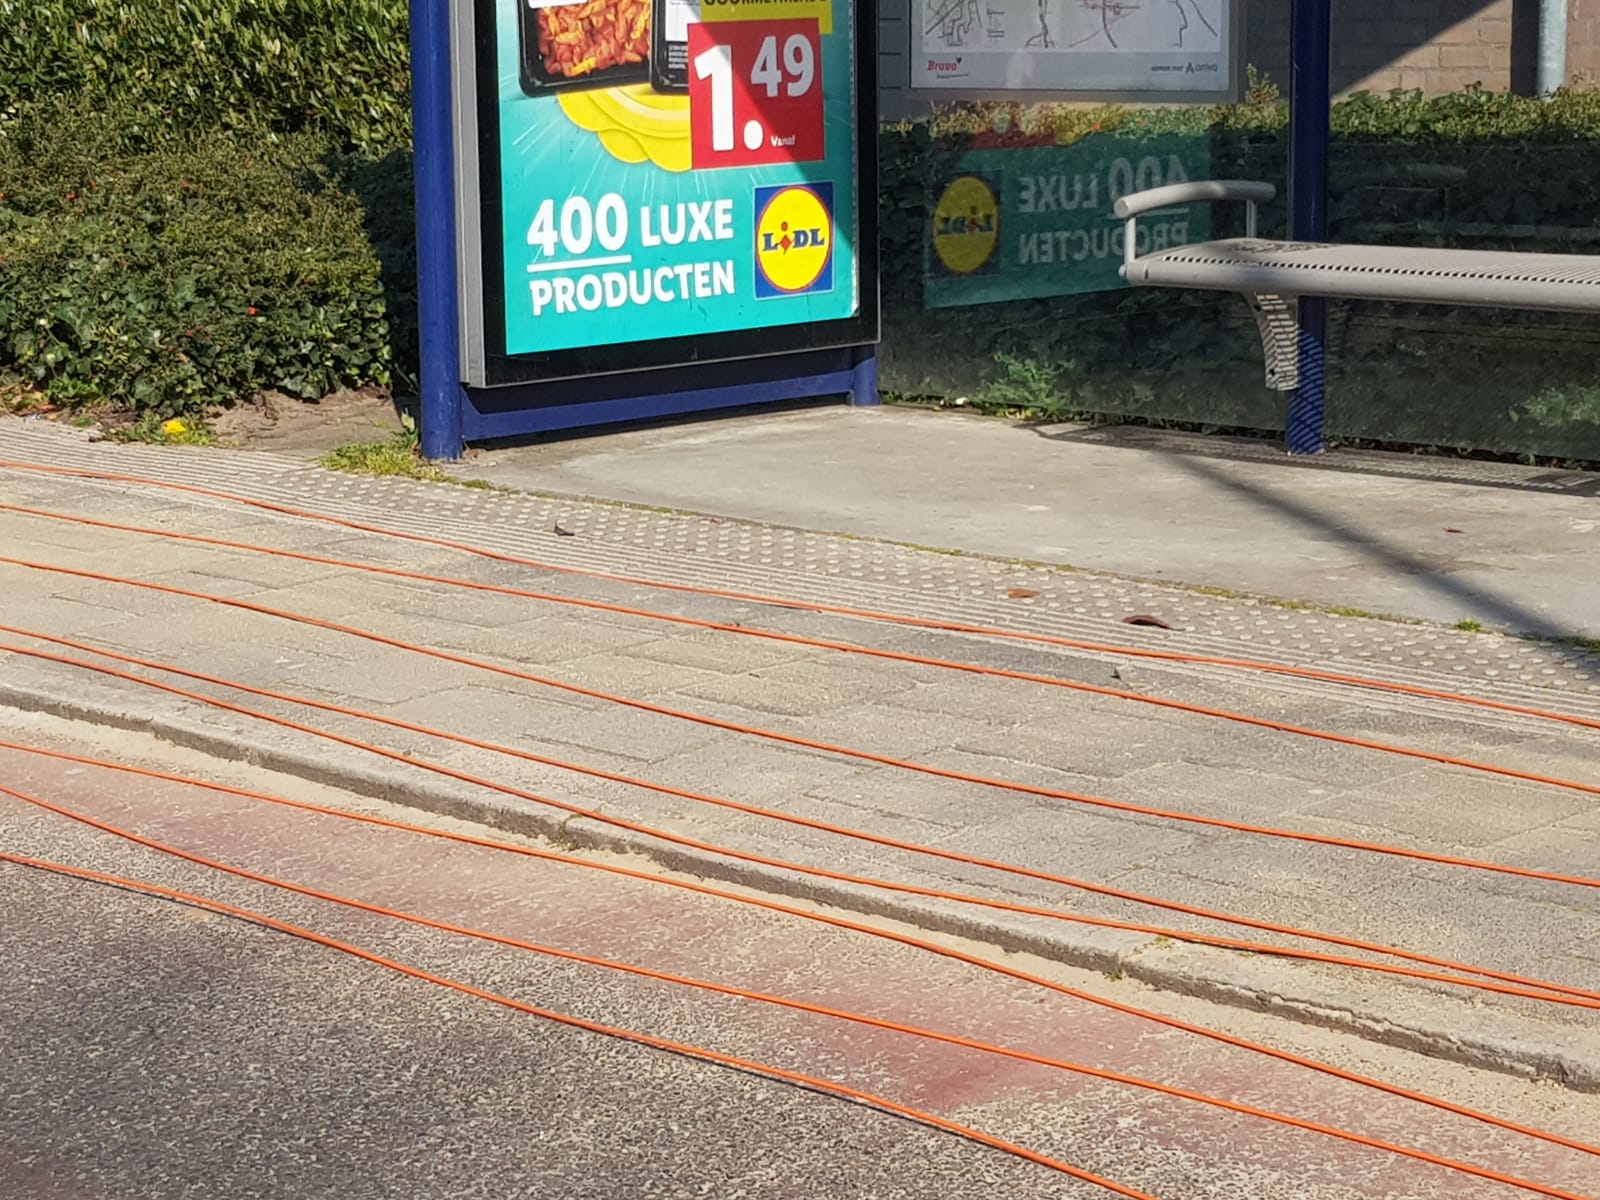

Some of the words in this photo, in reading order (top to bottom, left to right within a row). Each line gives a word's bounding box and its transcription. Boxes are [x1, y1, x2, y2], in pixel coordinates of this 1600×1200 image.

[750, 34, 814, 97] 49
[927, 60, 958, 72] Bravo
[526, 192, 629, 257] 400
[640, 199, 735, 247] LUXE
[762, 221, 826, 254] LIDL
[529, 260, 736, 316] PRODUCTEN
